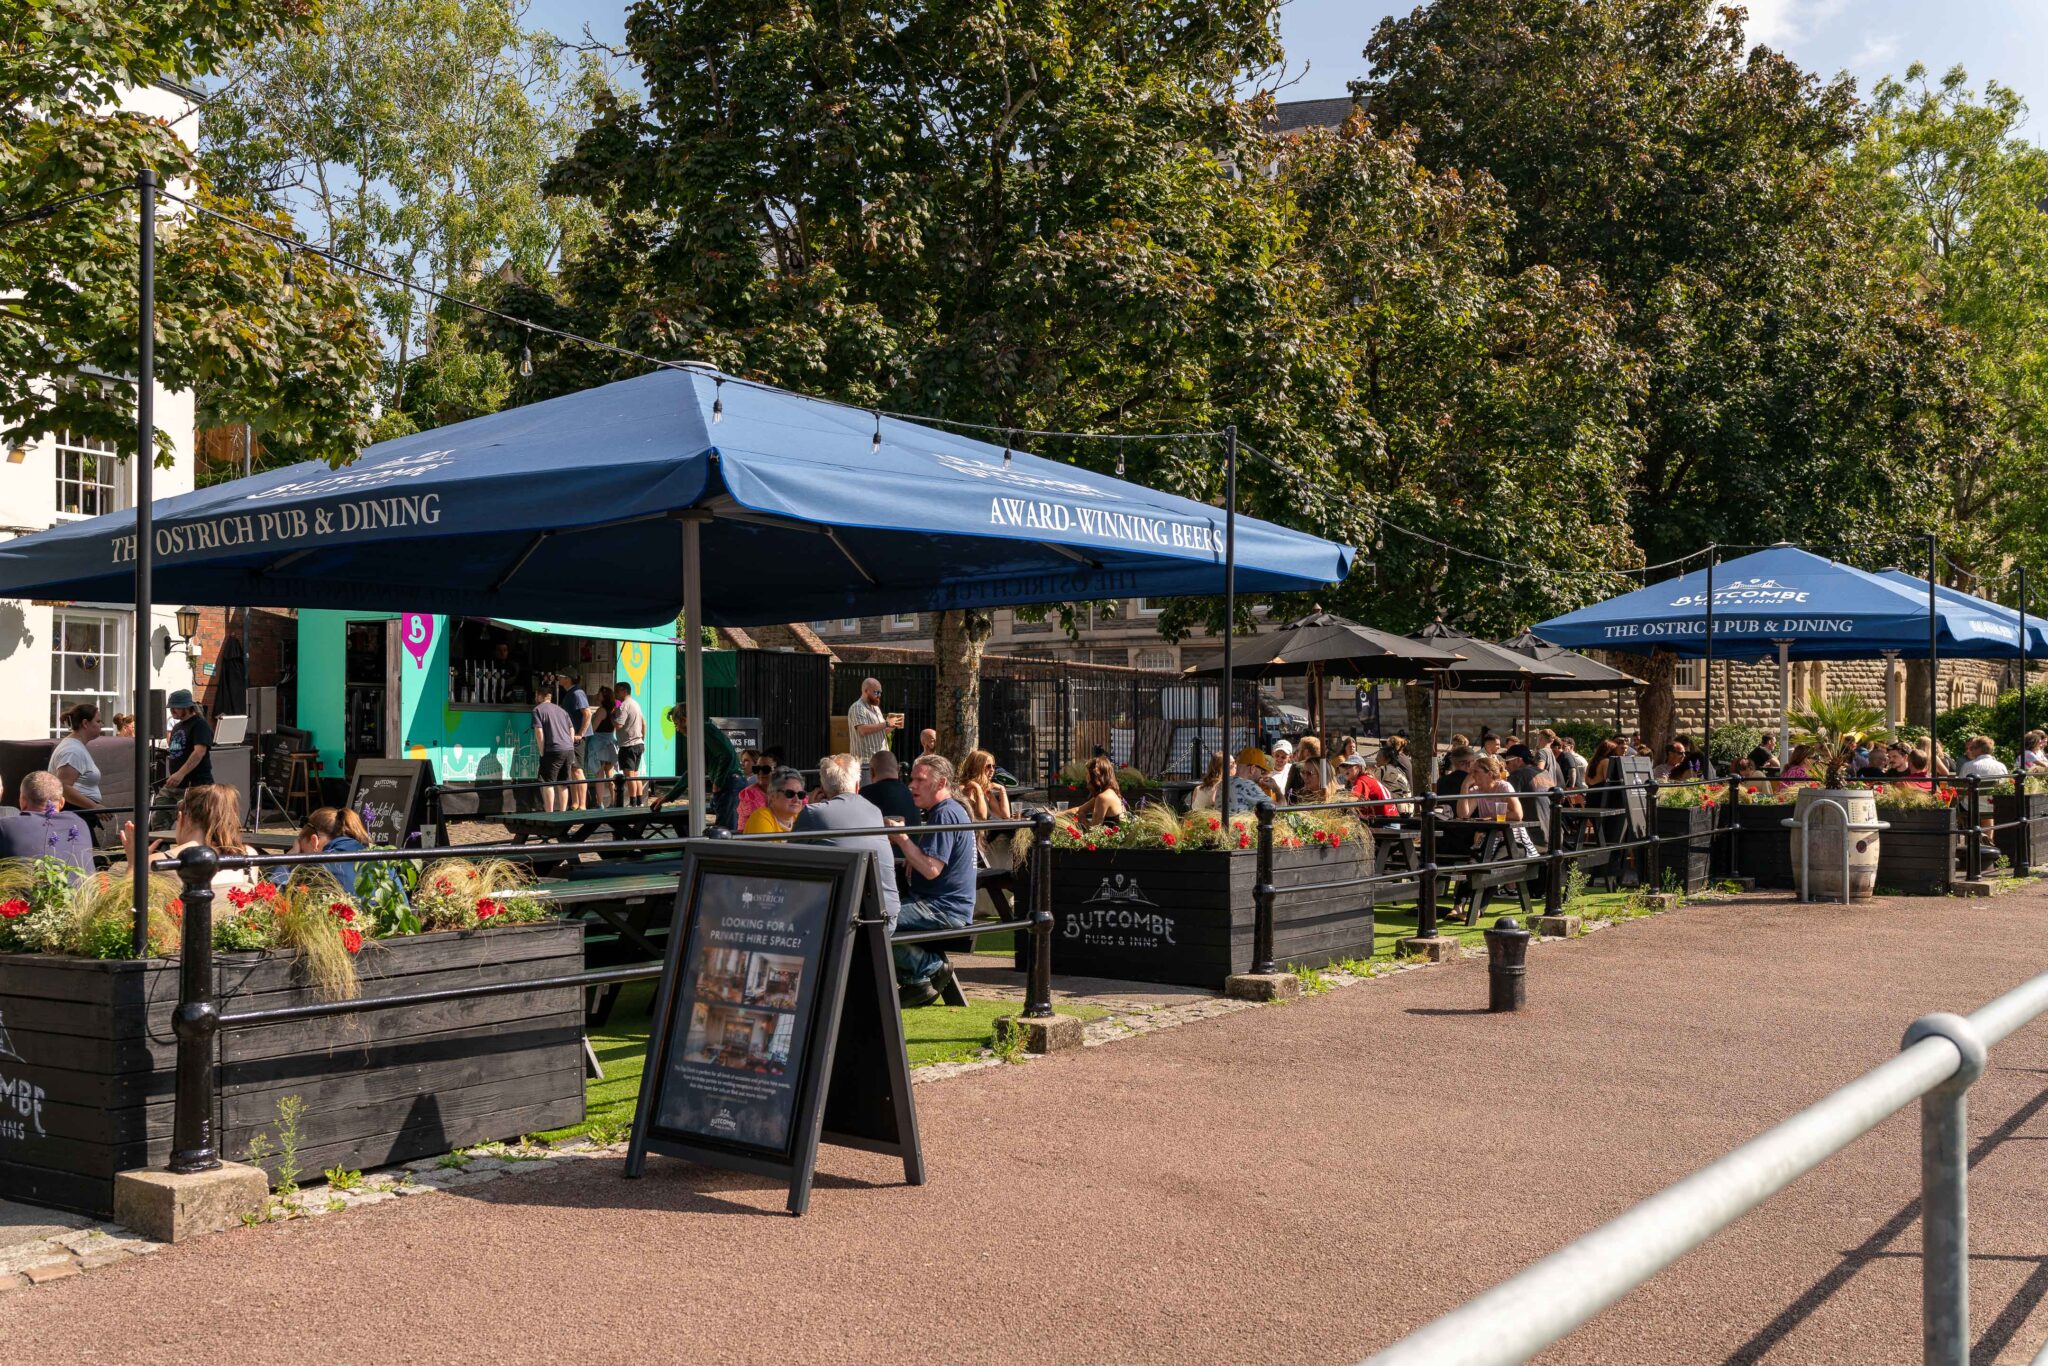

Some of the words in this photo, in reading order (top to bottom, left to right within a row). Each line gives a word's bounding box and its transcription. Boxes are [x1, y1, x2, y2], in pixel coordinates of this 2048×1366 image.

[111, 534, 137, 563] TH
[155, 515, 255, 556] OSTRICH
[258, 509, 308, 541] PUB
[314, 507, 335, 535] &
[338, 493, 441, 532] DINING
[990, 497, 1168, 546] AWARD-WINNING
[1172, 522, 1224, 553] BEERS
[1670, 591, 1810, 606] BUTCOMBE
[408, 615, 426, 643] B
[1604, 624, 1639, 638] THE
[1642, 620, 1719, 636] OSTRICH
[1725, 620, 1760, 634] PUB
[1764, 620, 1779, 632] &
[1783, 619, 1853, 632] DINING
[721, 916, 764, 930] LOOKING
[766, 920, 784, 932] FOR
[787, 922, 795, 932] A
[1063, 910, 1176, 945] BUTCOMBE
[709, 929, 745, 942] PRIVATE
[746, 933, 768, 945] HIRE
[1085, 934, 1114, 945] PUBS
[1118, 936, 1126, 946] &
[1129, 936, 1158, 947] INNS
[0, 1073, 46, 1138] MBE
